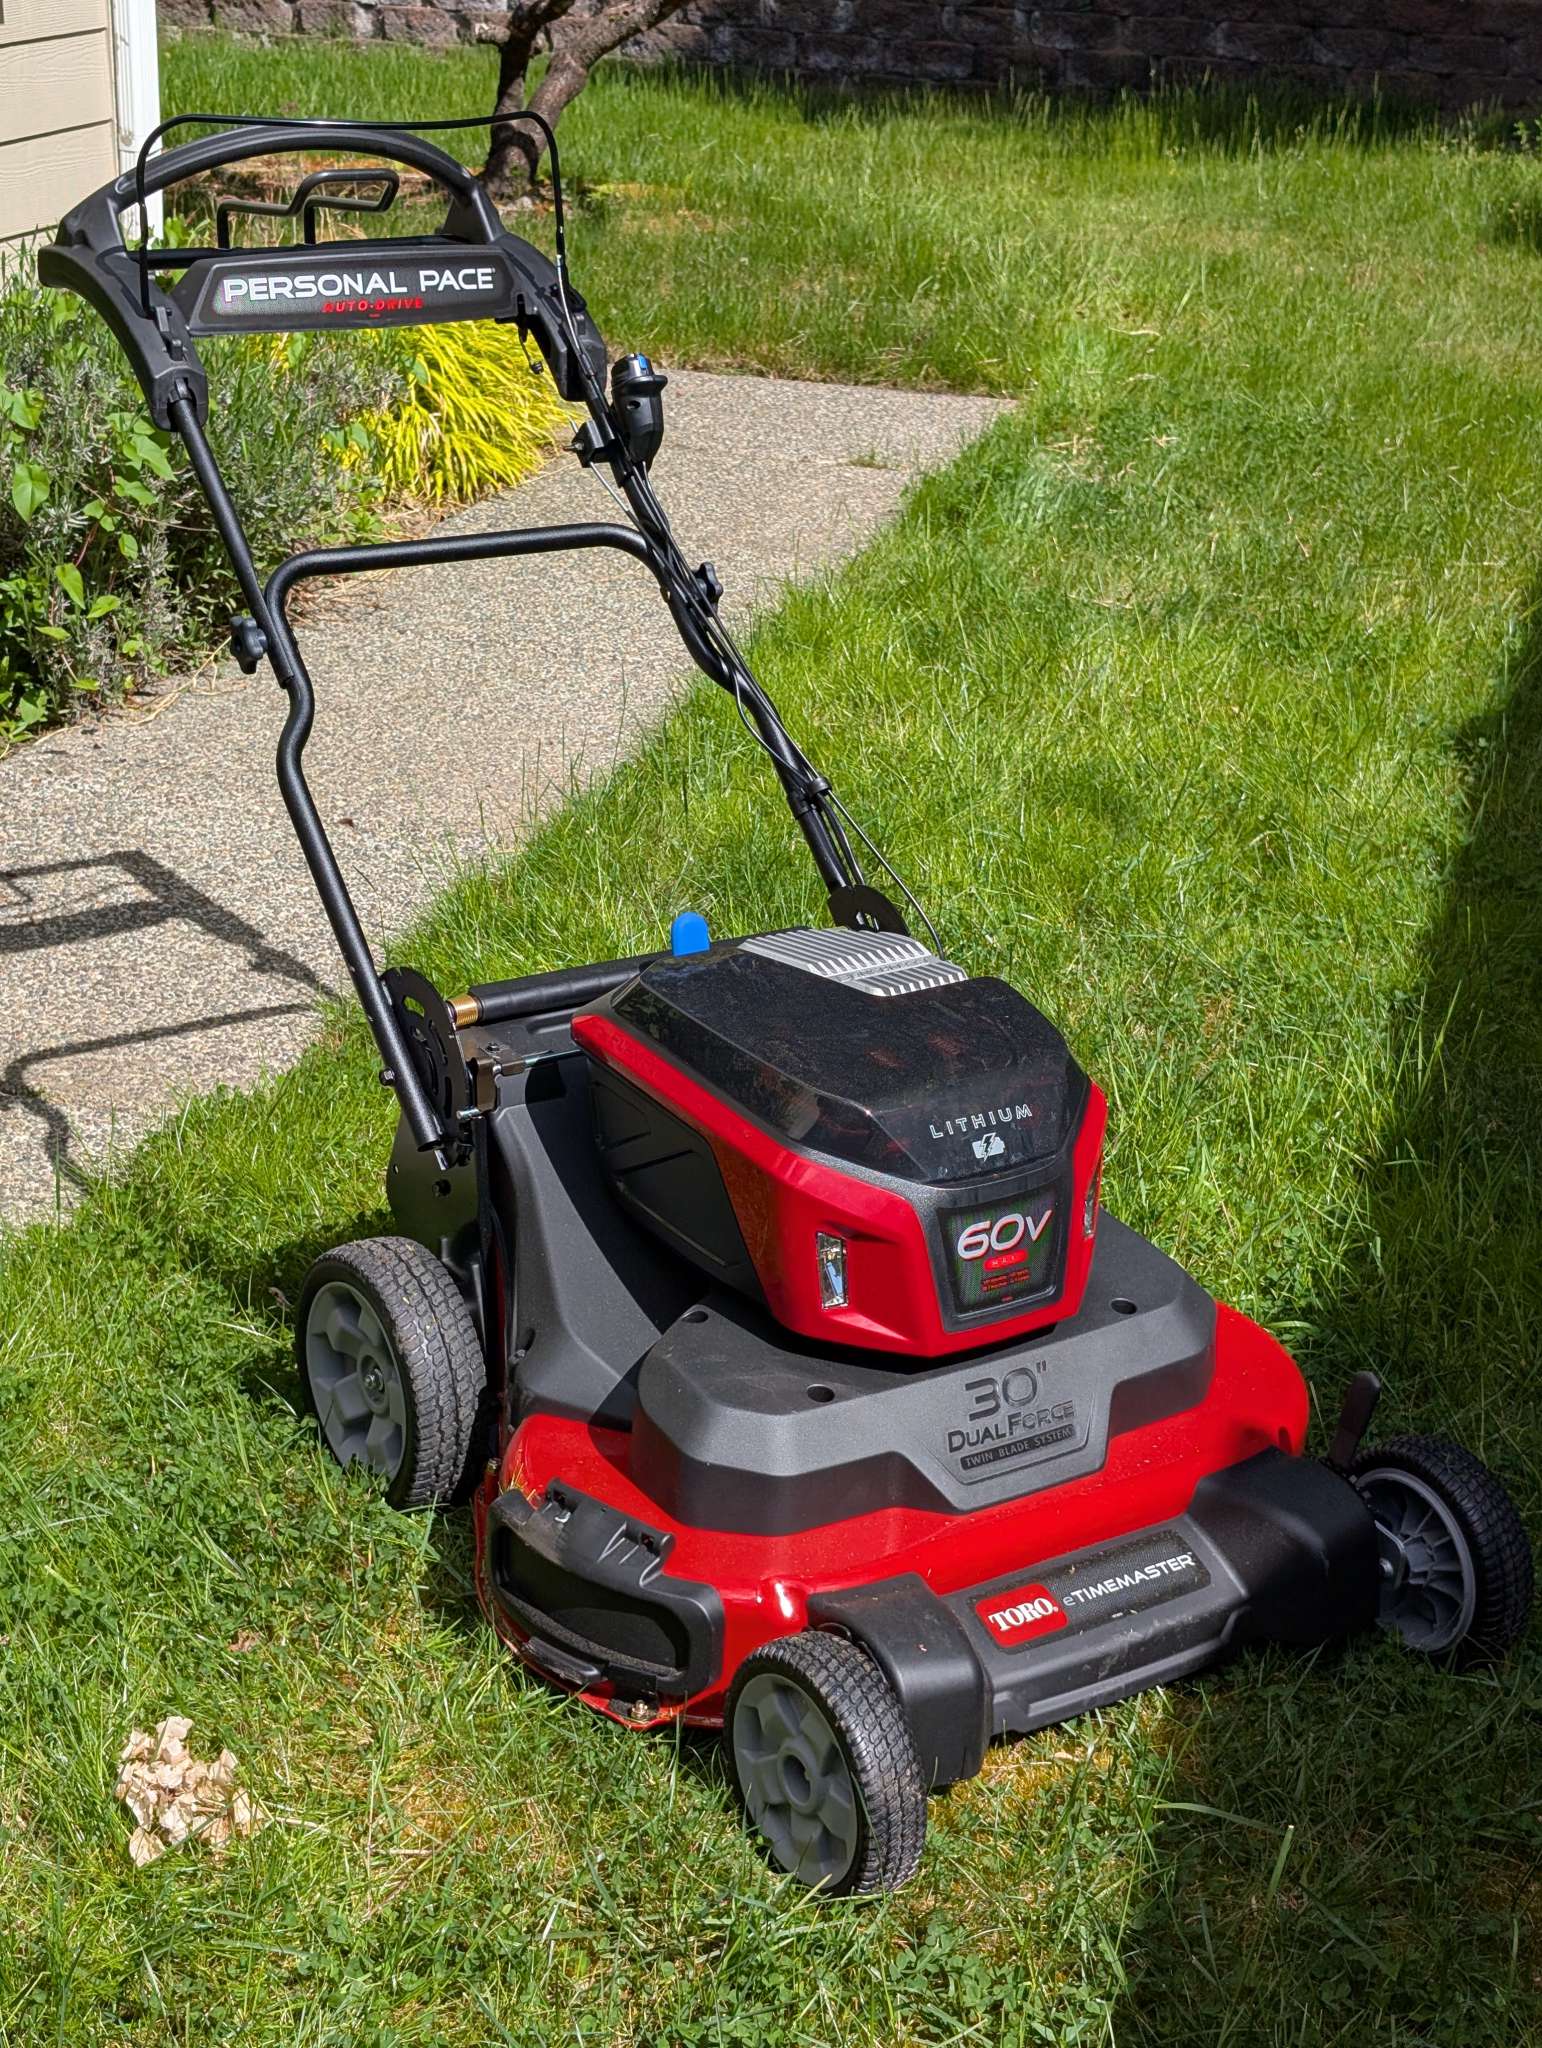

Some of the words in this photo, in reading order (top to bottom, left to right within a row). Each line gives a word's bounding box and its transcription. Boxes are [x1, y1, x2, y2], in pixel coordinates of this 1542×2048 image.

[223, 272, 407, 302] PERSONAL
[419, 268, 494, 292] PACE
[321, 297, 423, 313] AUTO-DRIVE
[929, 1103, 1032, 1139] LITHIUM
[957, 1209, 1053, 1260] 60V
[965, 1452, 994, 1468] TWIN
[999, 1438, 1031, 1457] BLADE
[1035, 1426, 1076, 1446] SYSTEM
[988, 1597, 1058, 1632] TORO
